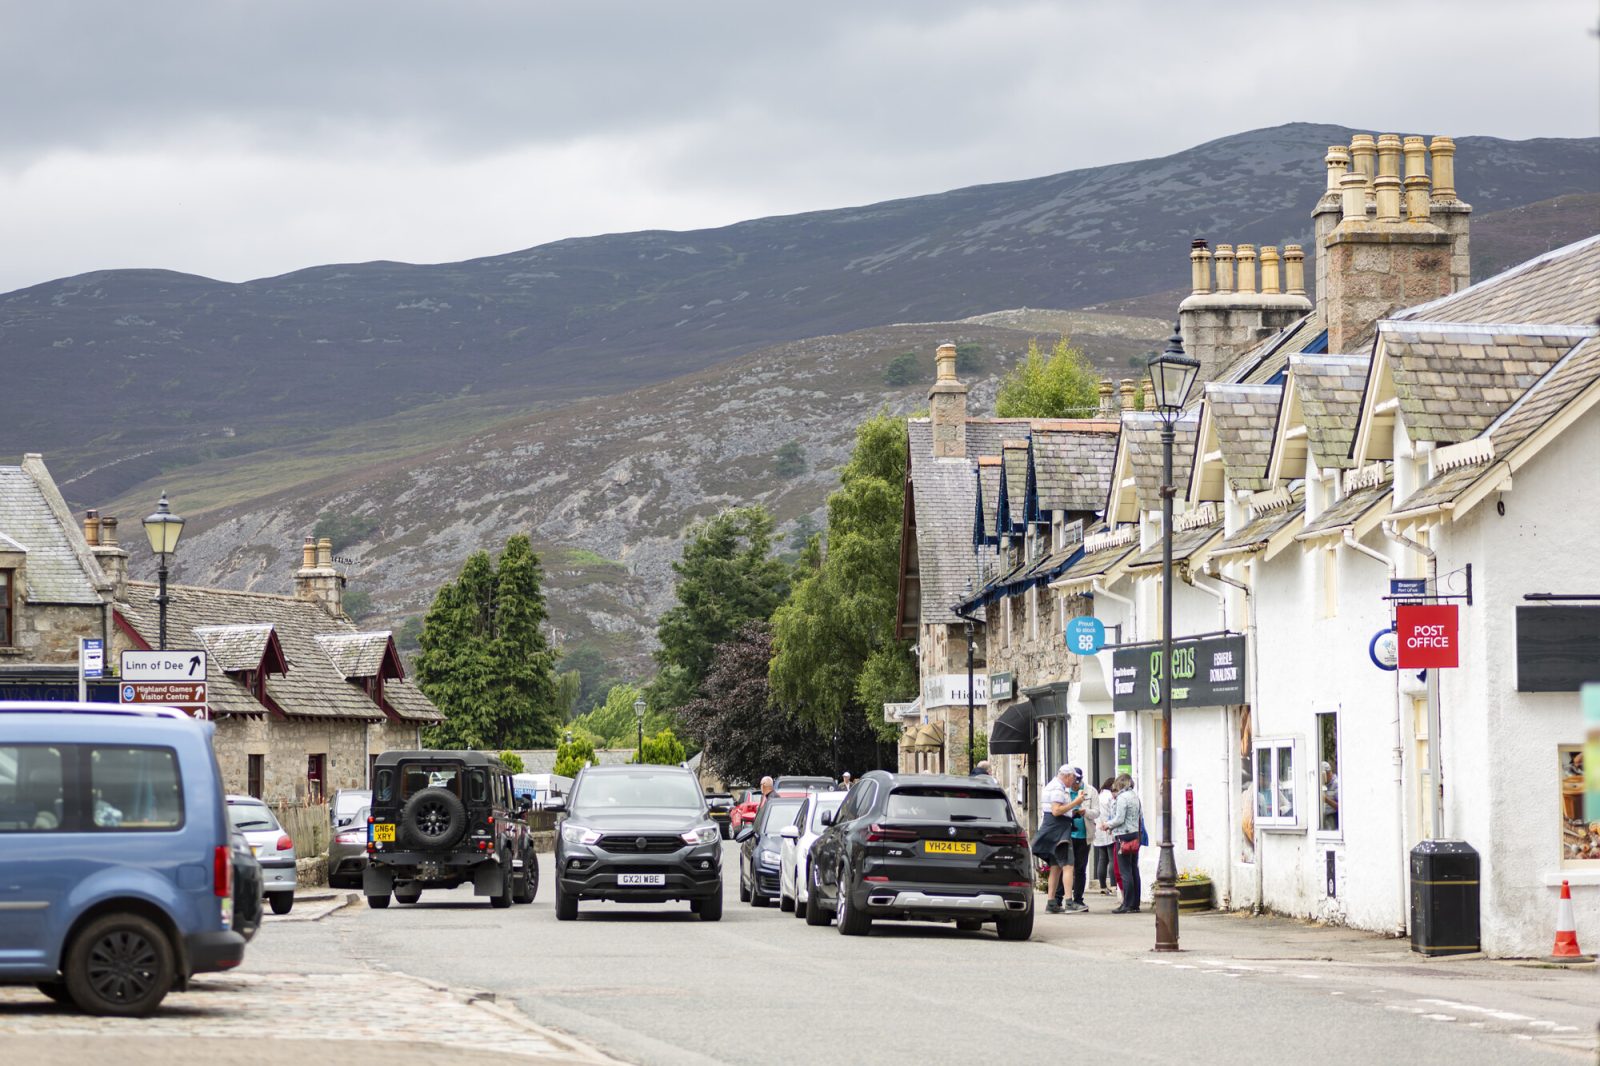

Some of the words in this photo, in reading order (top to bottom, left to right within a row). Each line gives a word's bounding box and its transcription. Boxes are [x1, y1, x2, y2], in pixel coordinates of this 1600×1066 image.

[1414, 626, 1444, 636] POST
[1407, 637, 1448, 648] OFFICE
[126, 661, 148, 670] Linn
[150, 661, 161, 670] of
[164, 661, 184, 670] Dee
[1150, 647, 1195, 704] grens
[954, 844, 972, 852] LSE
[623, 875, 641, 883] GX21
